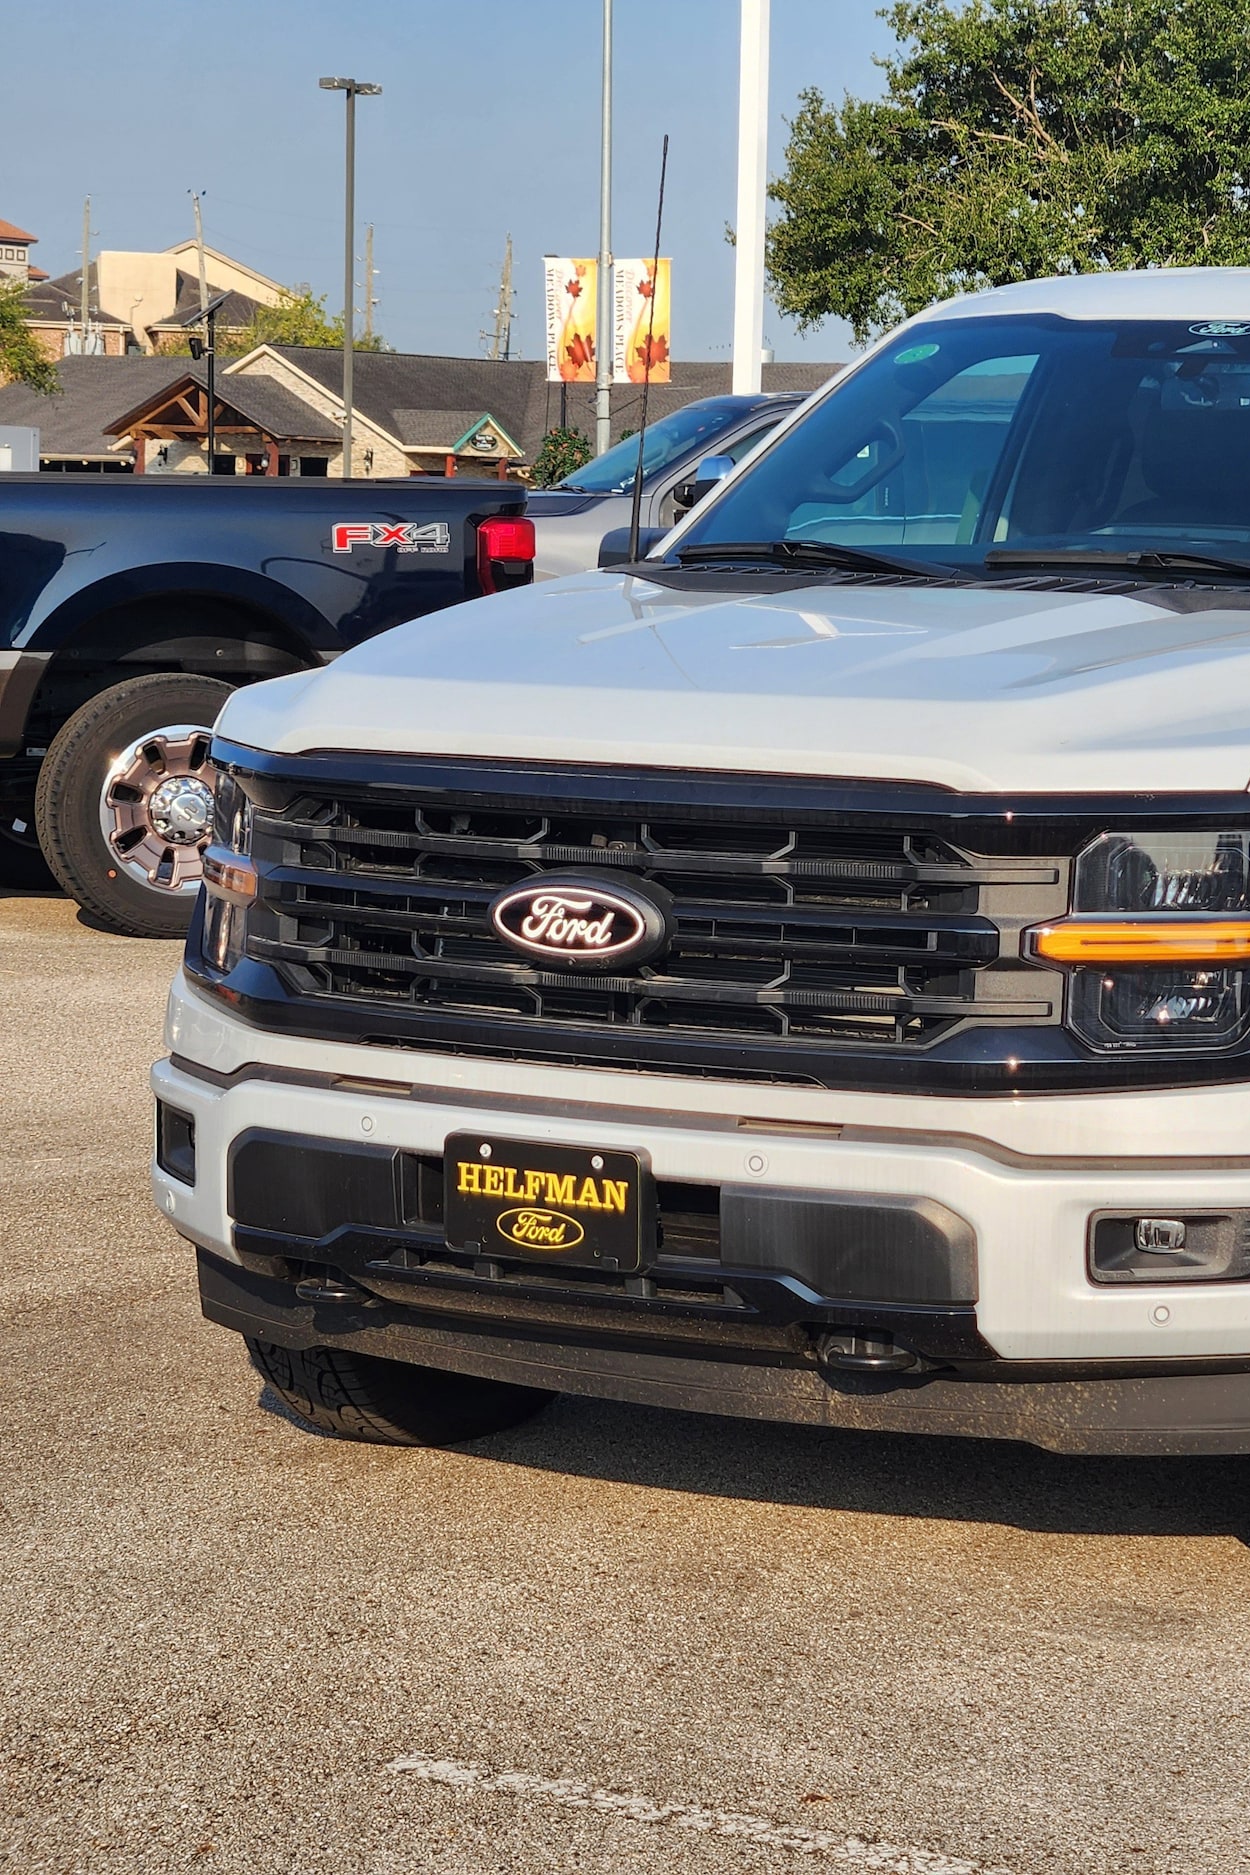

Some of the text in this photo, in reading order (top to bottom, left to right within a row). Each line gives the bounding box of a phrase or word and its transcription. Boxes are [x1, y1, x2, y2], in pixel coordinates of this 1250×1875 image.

[546, 268, 557, 372] MEADOWS PLACE
[615, 269, 624, 373] MEADOWS PLACE
[1199, 322, 1250, 334] Ford
[332, 523, 450, 553] FX4
[521, 895, 615, 945] Ford
[457, 1161, 630, 1213] HELFMAN
[511, 1211, 567, 1243] Ford
